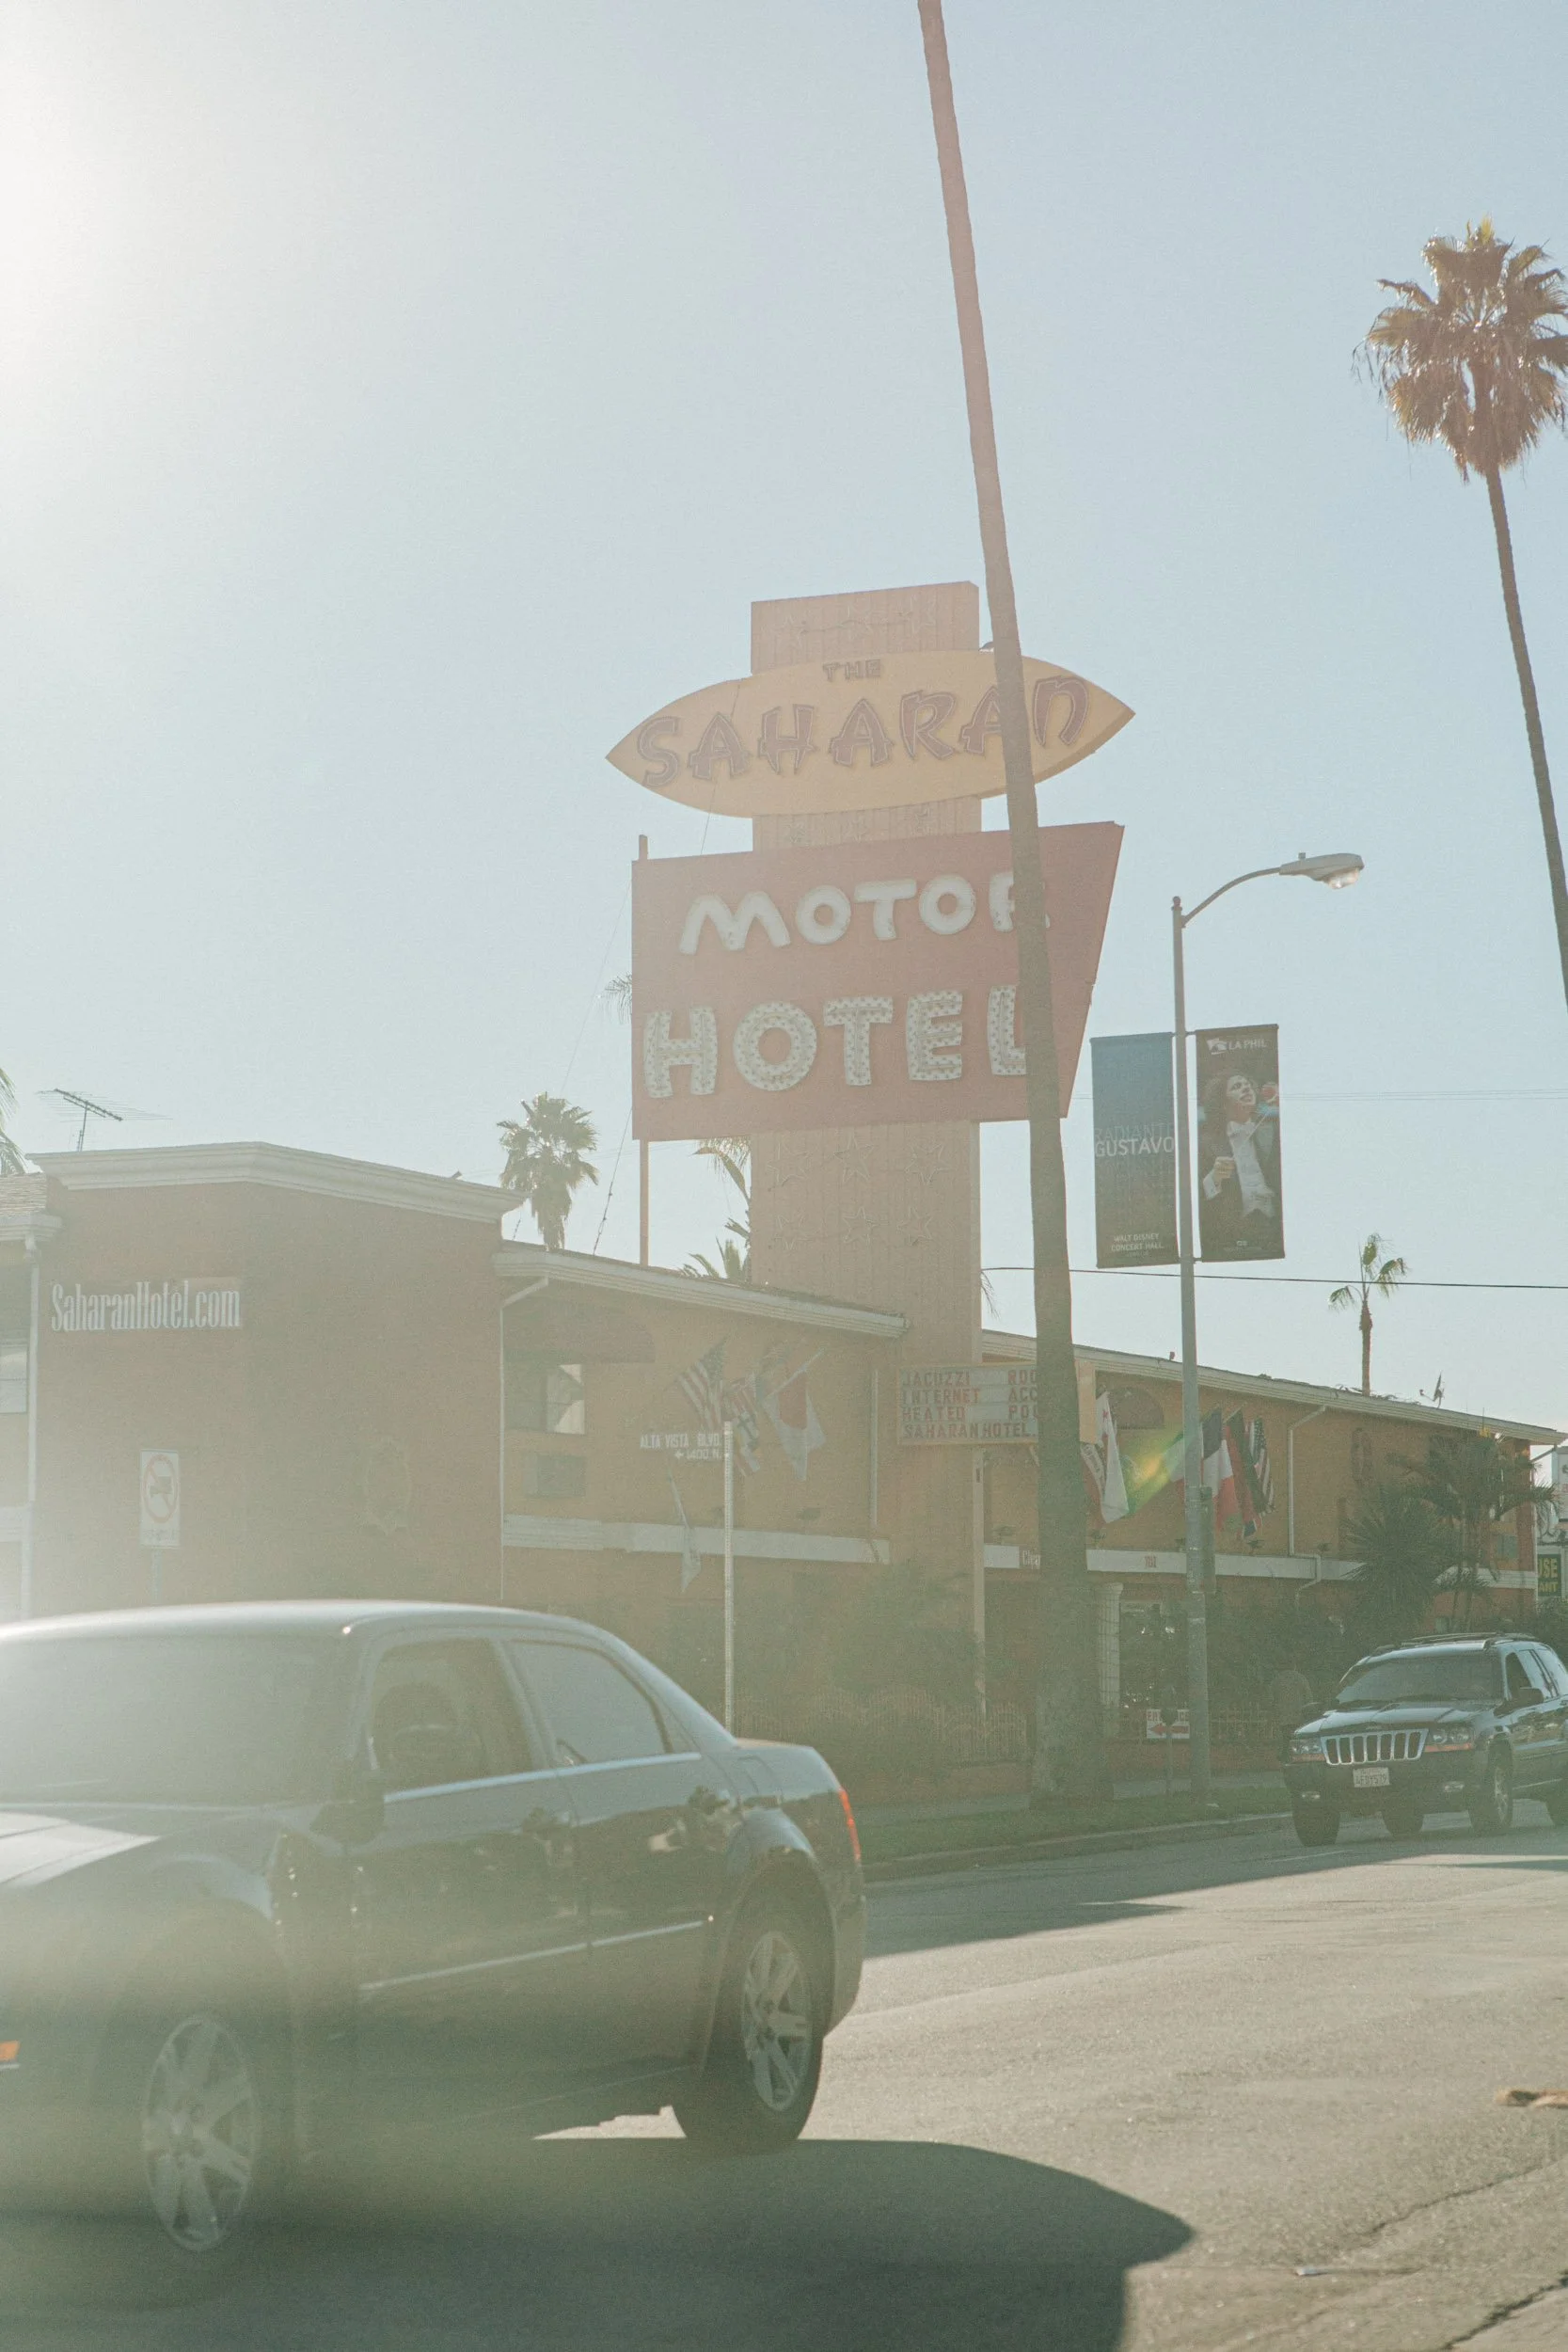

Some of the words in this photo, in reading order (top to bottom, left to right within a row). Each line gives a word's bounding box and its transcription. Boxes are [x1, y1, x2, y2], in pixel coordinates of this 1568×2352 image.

[823, 659, 882, 682] THE
[636, 675, 1090, 788] SAHARAN
[642, 984, 1027, 1098] HOTEL
[1228, 1040, 1242, 1050] LA
[1243, 1038, 1267, 1049] PHIL
[1095, 1136, 1174, 1157] GUSTAVO
[1114, 1233, 1132, 1242] WALT
[1133, 1232, 1160, 1241] DISNEY
[1111, 1243, 1144, 1252] CONCERT
[1145, 1241, 1164, 1250] HALL
[51, 1279, 241, 1331] SaharanHotel.com
[902, 1370, 971, 1387] JACUZZI
[903, 1387, 980, 1405] INTERNET
[1008, 1386, 1037, 1403] ACC
[902, 1405, 965, 1422] HEATED
[640, 1433, 661, 1449] ALTA
[665, 1433, 689, 1449] VISTA
